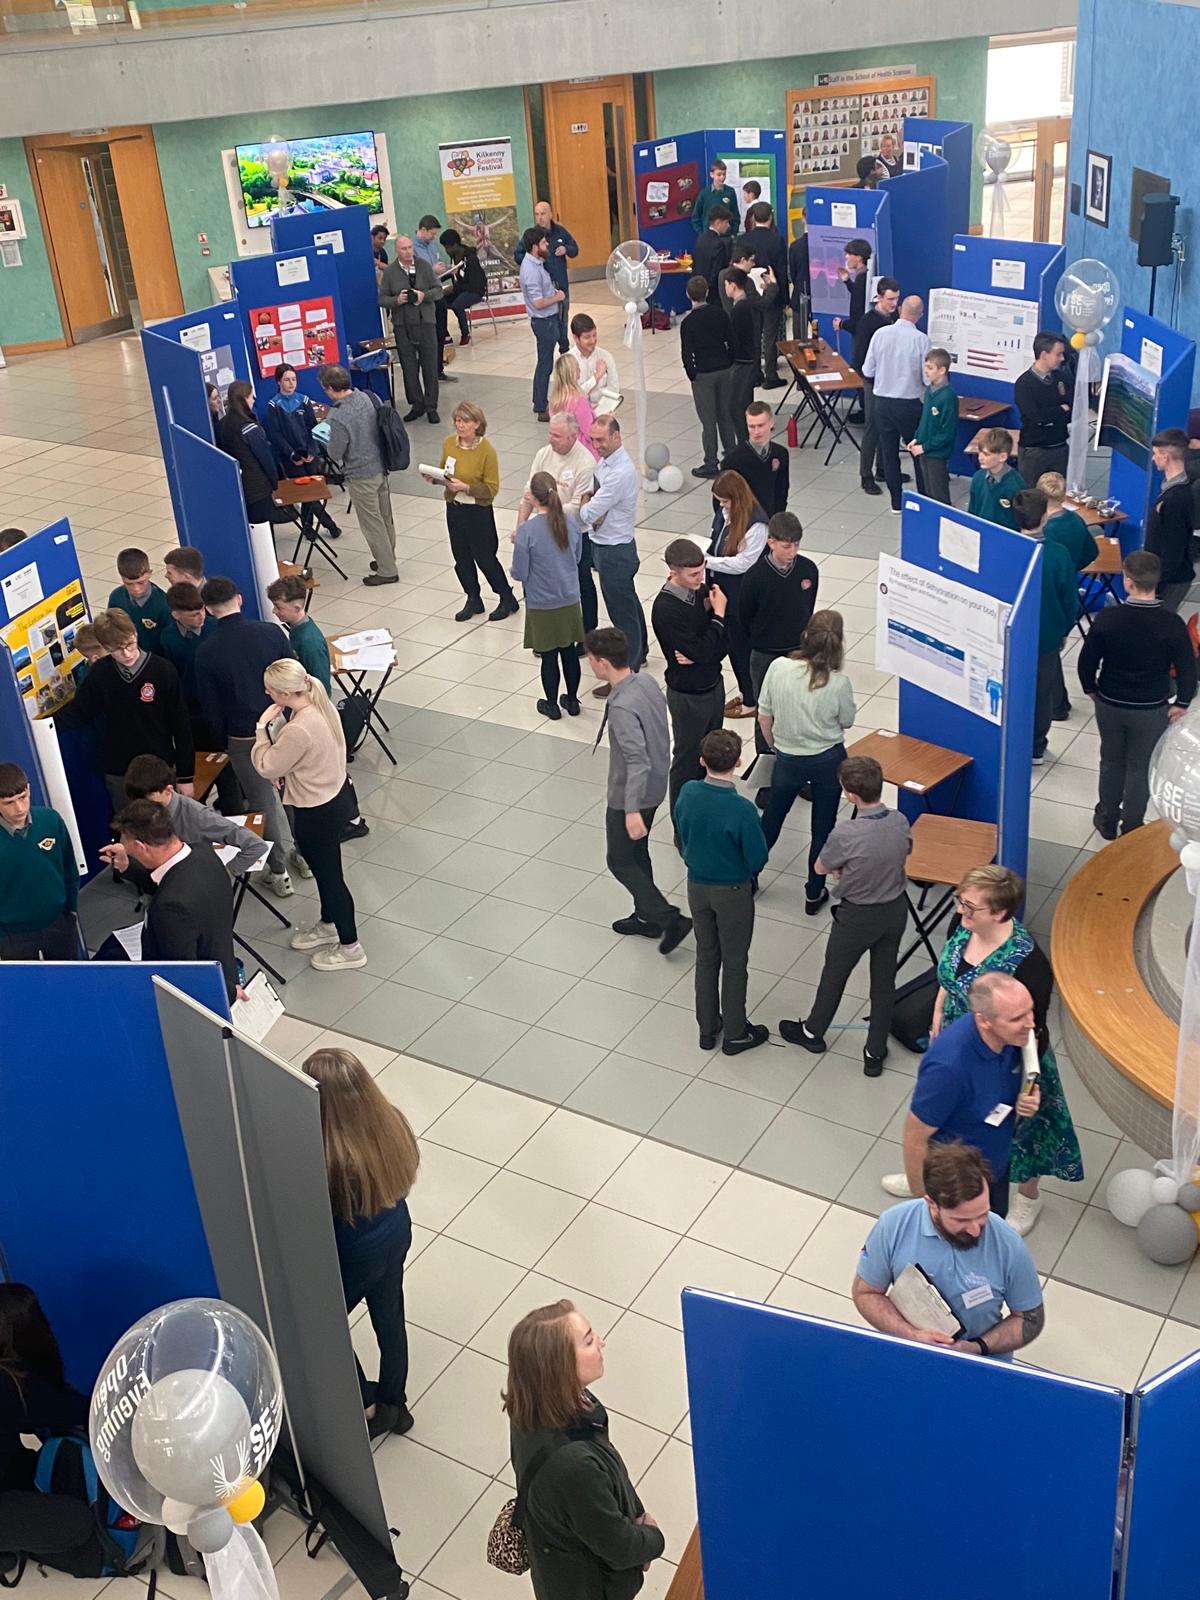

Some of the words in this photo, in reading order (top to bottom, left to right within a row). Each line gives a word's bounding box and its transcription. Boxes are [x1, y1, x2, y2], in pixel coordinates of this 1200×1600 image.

[855, 72, 870, 80] School
[871, 71, 876, 79] of
[877, 70, 892, 78] Health
[476, 158, 503, 166] Science
[477, 163, 504, 172] Festival
[640, 269, 650, 279] SE
[640, 279, 650, 288] TU
[1070, 293, 1083, 306] SE
[1070, 305, 1082, 316] TU
[889, 567, 900, 578] The
[901, 573, 918, 585] effect
[919, 578, 926, 587] of
[926, 581, 960, 602] dehydration
[960, 597, 969, 605] on
[968, 600, 982, 611] your
[982, 605, 997, 620] body
[1163, 781, 1184, 807] SE
[1162, 799, 1182, 823] TU
[249, 1406, 275, 1454] SE
[254, 1433, 277, 1475] TU
